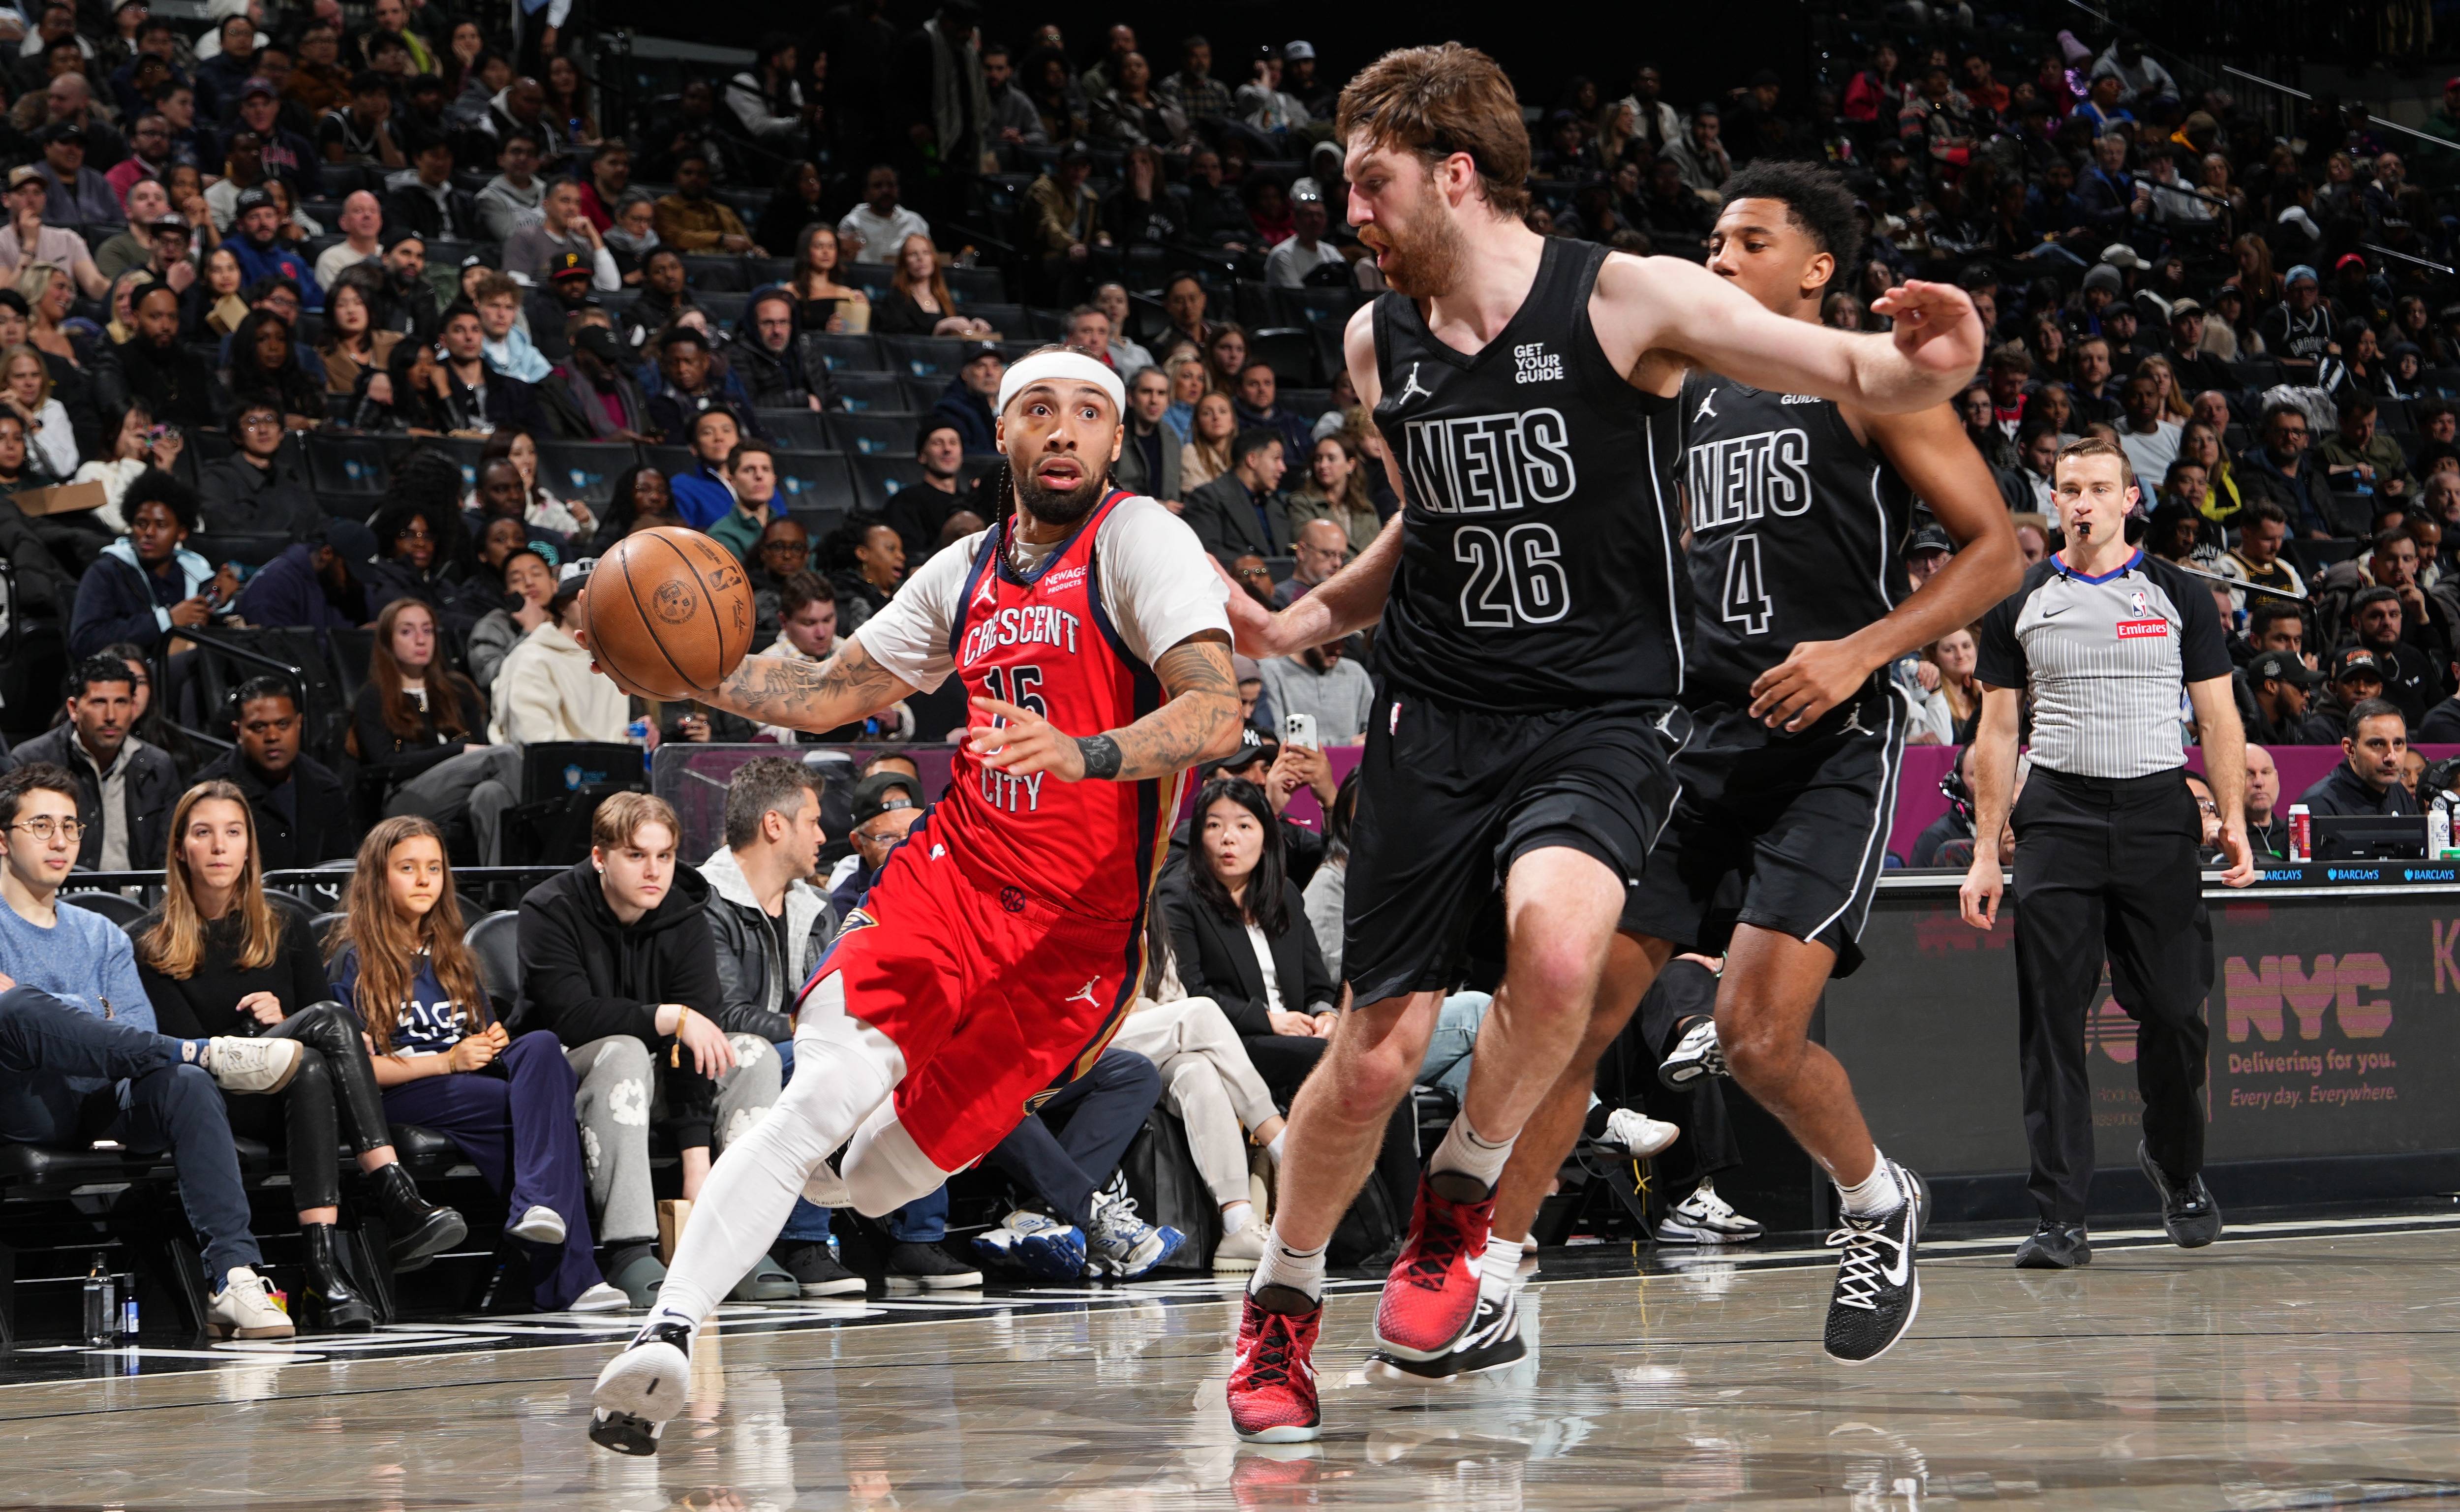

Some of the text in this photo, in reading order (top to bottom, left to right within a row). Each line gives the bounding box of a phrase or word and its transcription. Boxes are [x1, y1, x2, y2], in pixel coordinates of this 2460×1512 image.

[1514, 342, 1544, 358] GET
[1515, 354, 1561, 370] YOUR
[1516, 367, 1564, 384] GUIDE
[1404, 407, 1576, 514] NETS
[1688, 428, 1813, 533] NETS
[1045, 565, 1086, 586] NEWAGE
[1047, 579, 1081, 594] PRODUCTS
[1454, 523, 1570, 628] 26
[1722, 533, 1773, 635] 4
[963, 605, 1080, 667] CRESCENT
[2119, 622, 2166, 636] Emirates
[984, 665, 1047, 754] 15
[981, 768, 1044, 812] CITY
[2265, 869, 2302, 881] ARCLAYS
[2338, 869, 2379, 880] BARCLAYS
[2414, 869, 2455, 880] BARCLAYS
[2224, 953, 2393, 1043] NYC
[2228, 1048, 2397, 1078] Delivering for you.
[2230, 1082, 2398, 1111] Every day. Everywhere.
